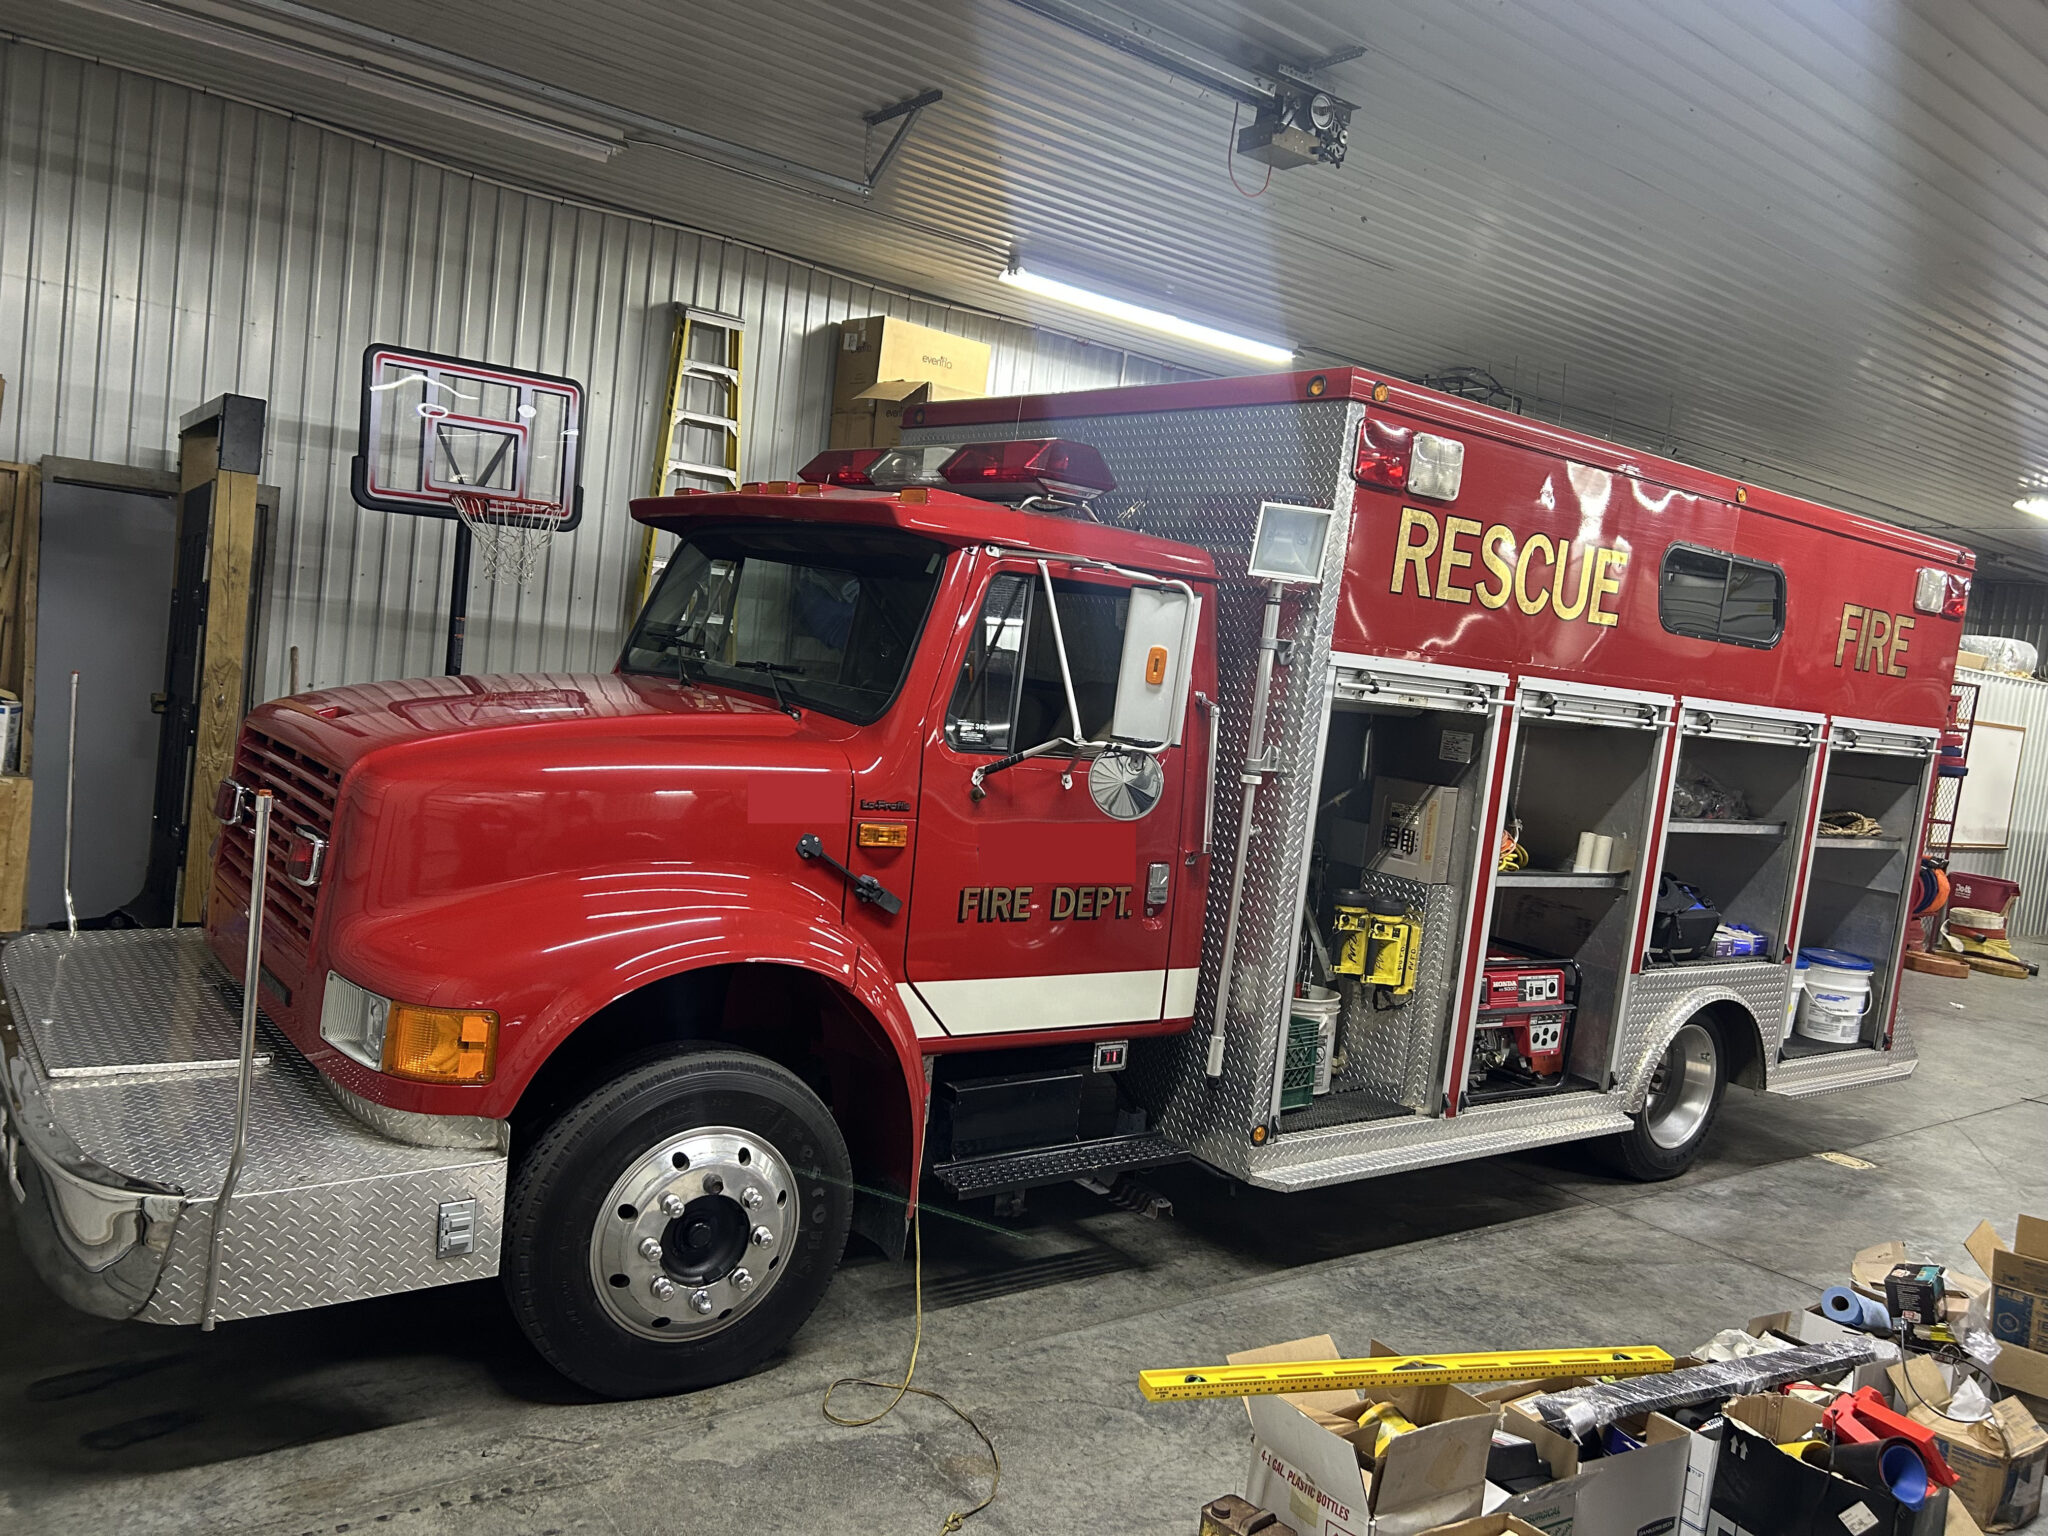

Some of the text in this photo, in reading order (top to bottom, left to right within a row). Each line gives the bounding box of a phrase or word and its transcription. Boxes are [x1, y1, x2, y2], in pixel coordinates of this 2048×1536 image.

[1389, 505, 1630, 628] RESCUE
[1834, 602, 1916, 678] FIRE
[957, 886, 1132, 923] FIRE DEPT.
[1261, 1450, 1350, 1521] 4-1 GAL. PLASTIC BOTTLES
